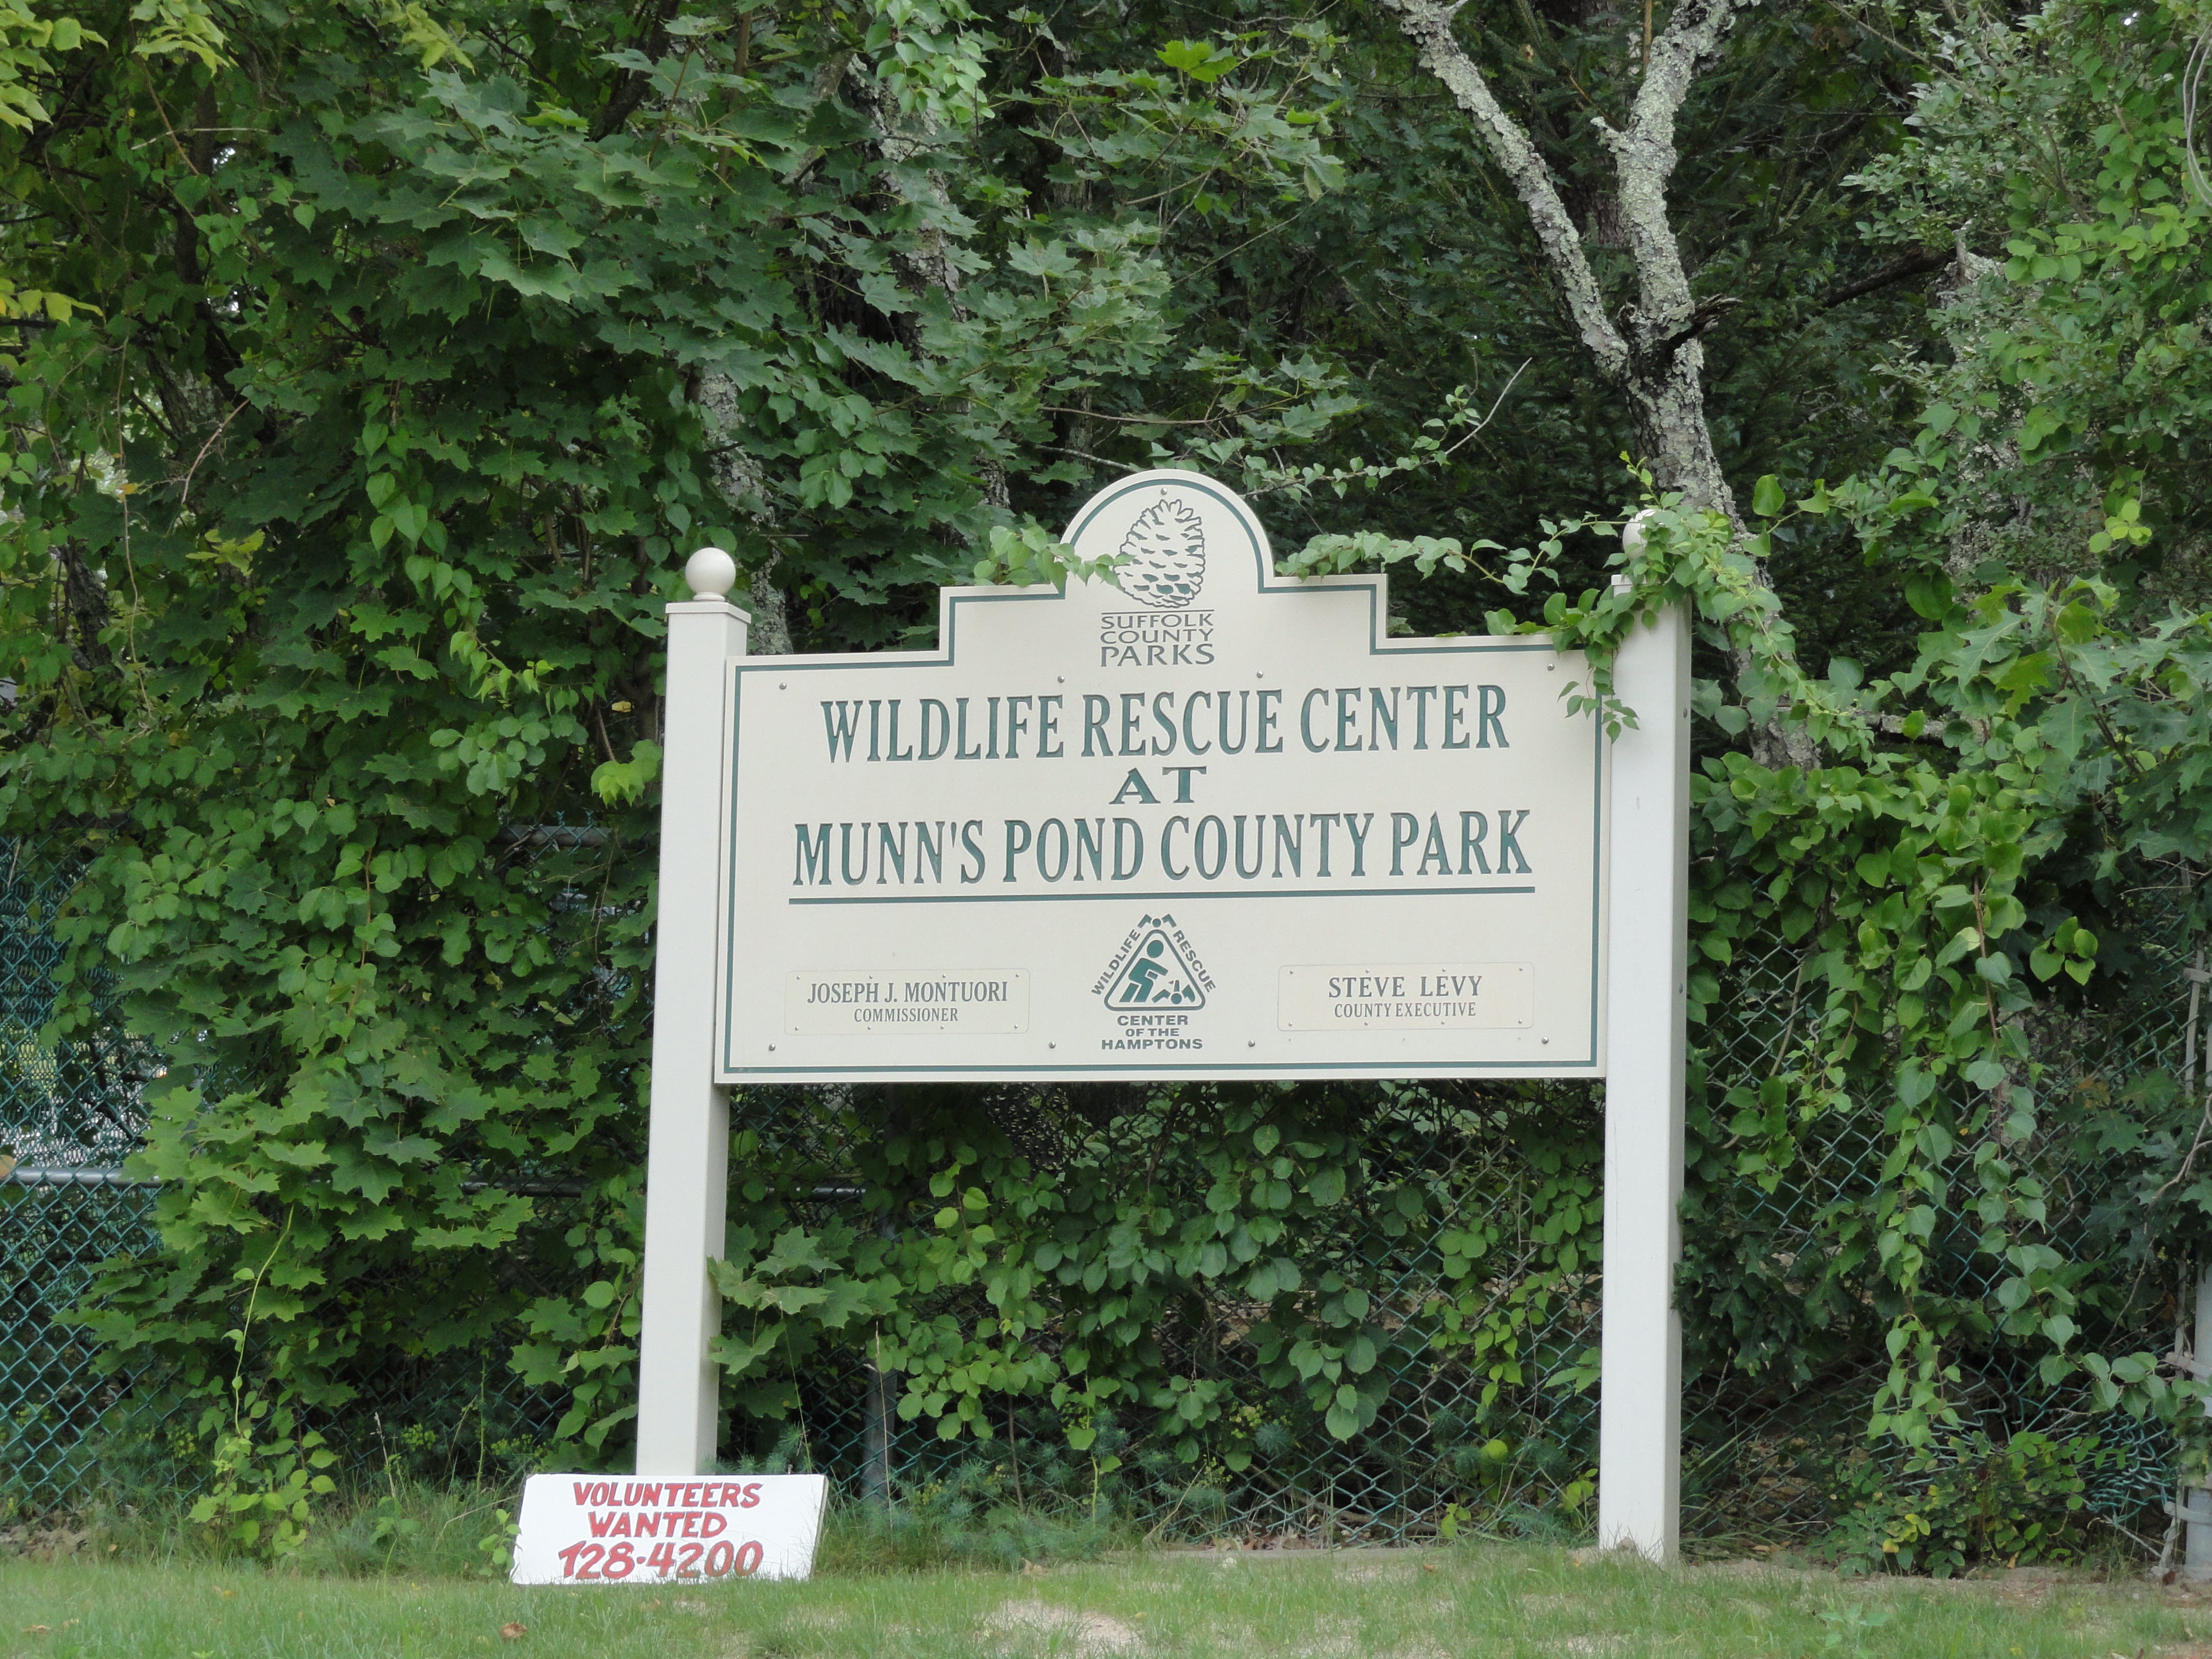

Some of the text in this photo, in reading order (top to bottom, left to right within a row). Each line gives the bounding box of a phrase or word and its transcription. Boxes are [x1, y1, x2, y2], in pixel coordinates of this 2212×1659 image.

[1101, 614, 1213, 629] SUFFOLK
[1100, 629, 1214, 644] COUNTY
[1100, 644, 1214, 667] PARKS
[821, 685, 1509, 763] WILDLIFE RESCUE CENTER
[1109, 767, 1207, 804] AT
[793, 810, 1533, 886] MUNN'S POND COUNTY PARK
[1091, 929, 1140, 995] WILDLIFE
[1173, 930, 1216, 992] RESCUE
[807, 982, 1008, 1003] JOSEPH J. MONTUORI
[1328, 975, 1482, 998] STEVE LEVY
[854, 1008, 958, 1022] COMMISSIONER
[1117, 1015, 1188, 1026] CENTER
[1334, 1002, 1476, 1017] COUNTY EXECUTIVE
[1101, 1038, 1203, 1050] HAMPTONS
[1125, 1028, 1179, 1037] OF THE
[573, 1482, 763, 1508] VOLUNTEERS
[587, 1511, 727, 1537] WANTED
